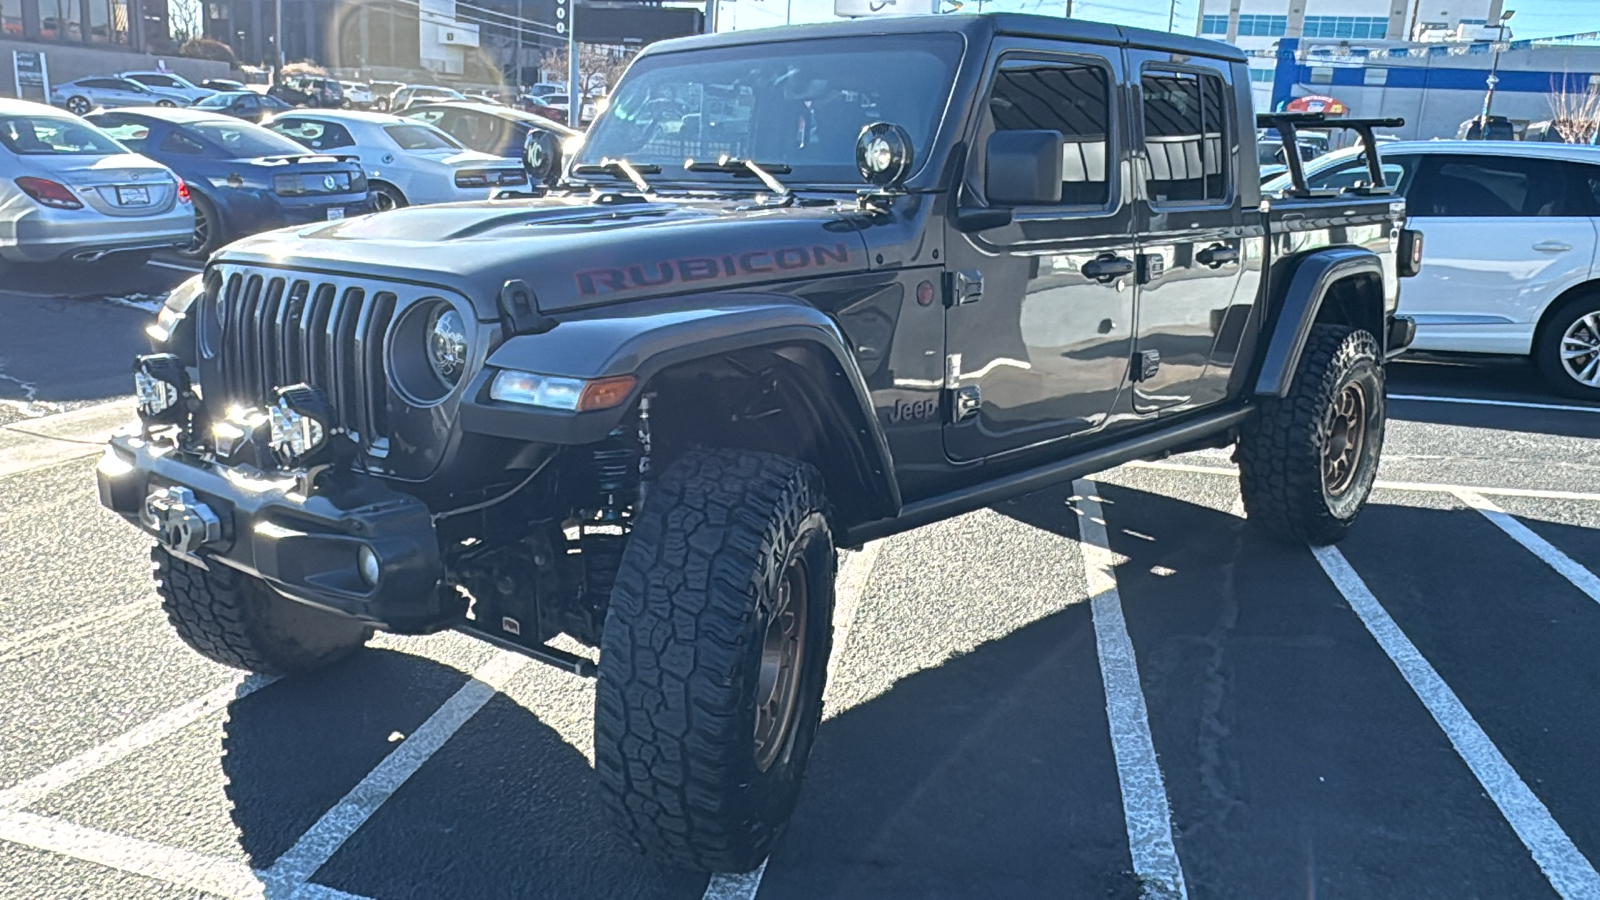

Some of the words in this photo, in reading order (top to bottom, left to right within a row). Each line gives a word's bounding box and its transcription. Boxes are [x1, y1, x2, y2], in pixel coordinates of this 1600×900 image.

[527, 142, 543, 167] KC
[575, 243, 849, 297] RUBICON
[888, 399, 936, 424] Jeep
